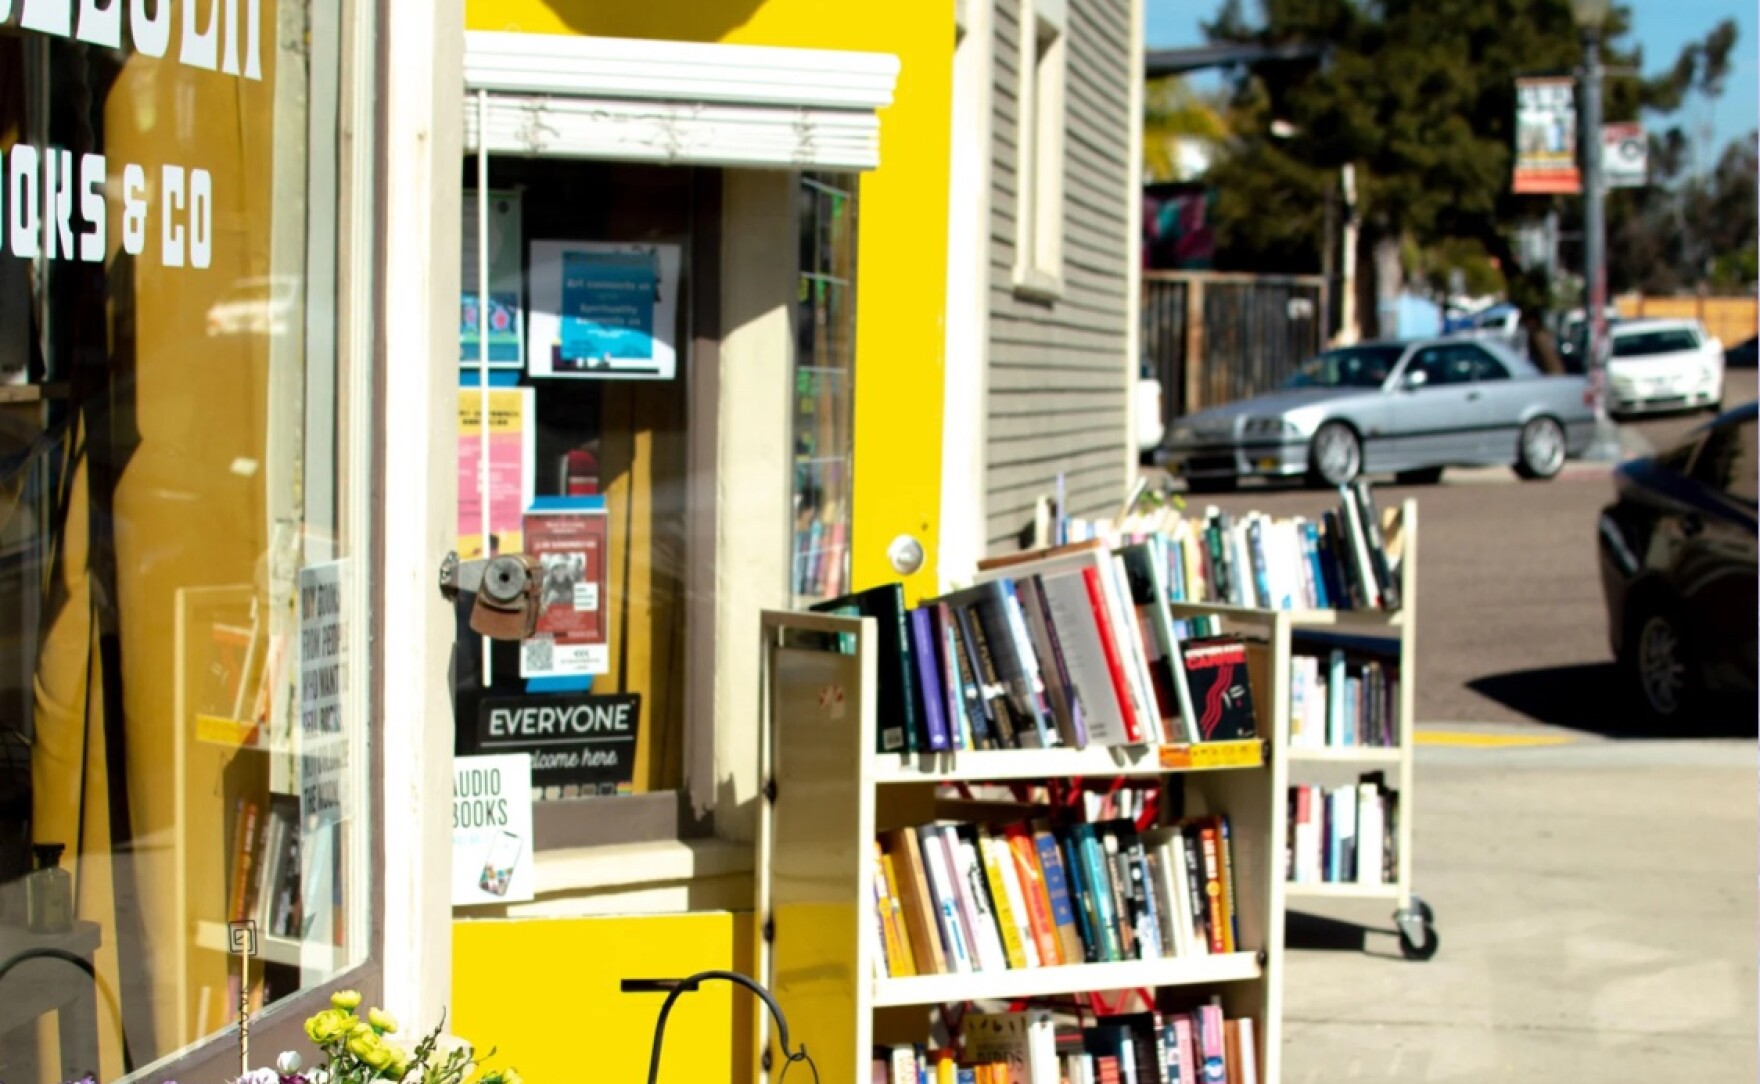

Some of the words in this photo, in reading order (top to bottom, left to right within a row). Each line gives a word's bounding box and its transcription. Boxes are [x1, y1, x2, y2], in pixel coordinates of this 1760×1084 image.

[0, 144, 106, 262] OKS
[123, 163, 148, 255] &
[162, 164, 212, 269] CO
[489, 704, 630, 736] EVERYONE
[581, 747, 619, 767] here
